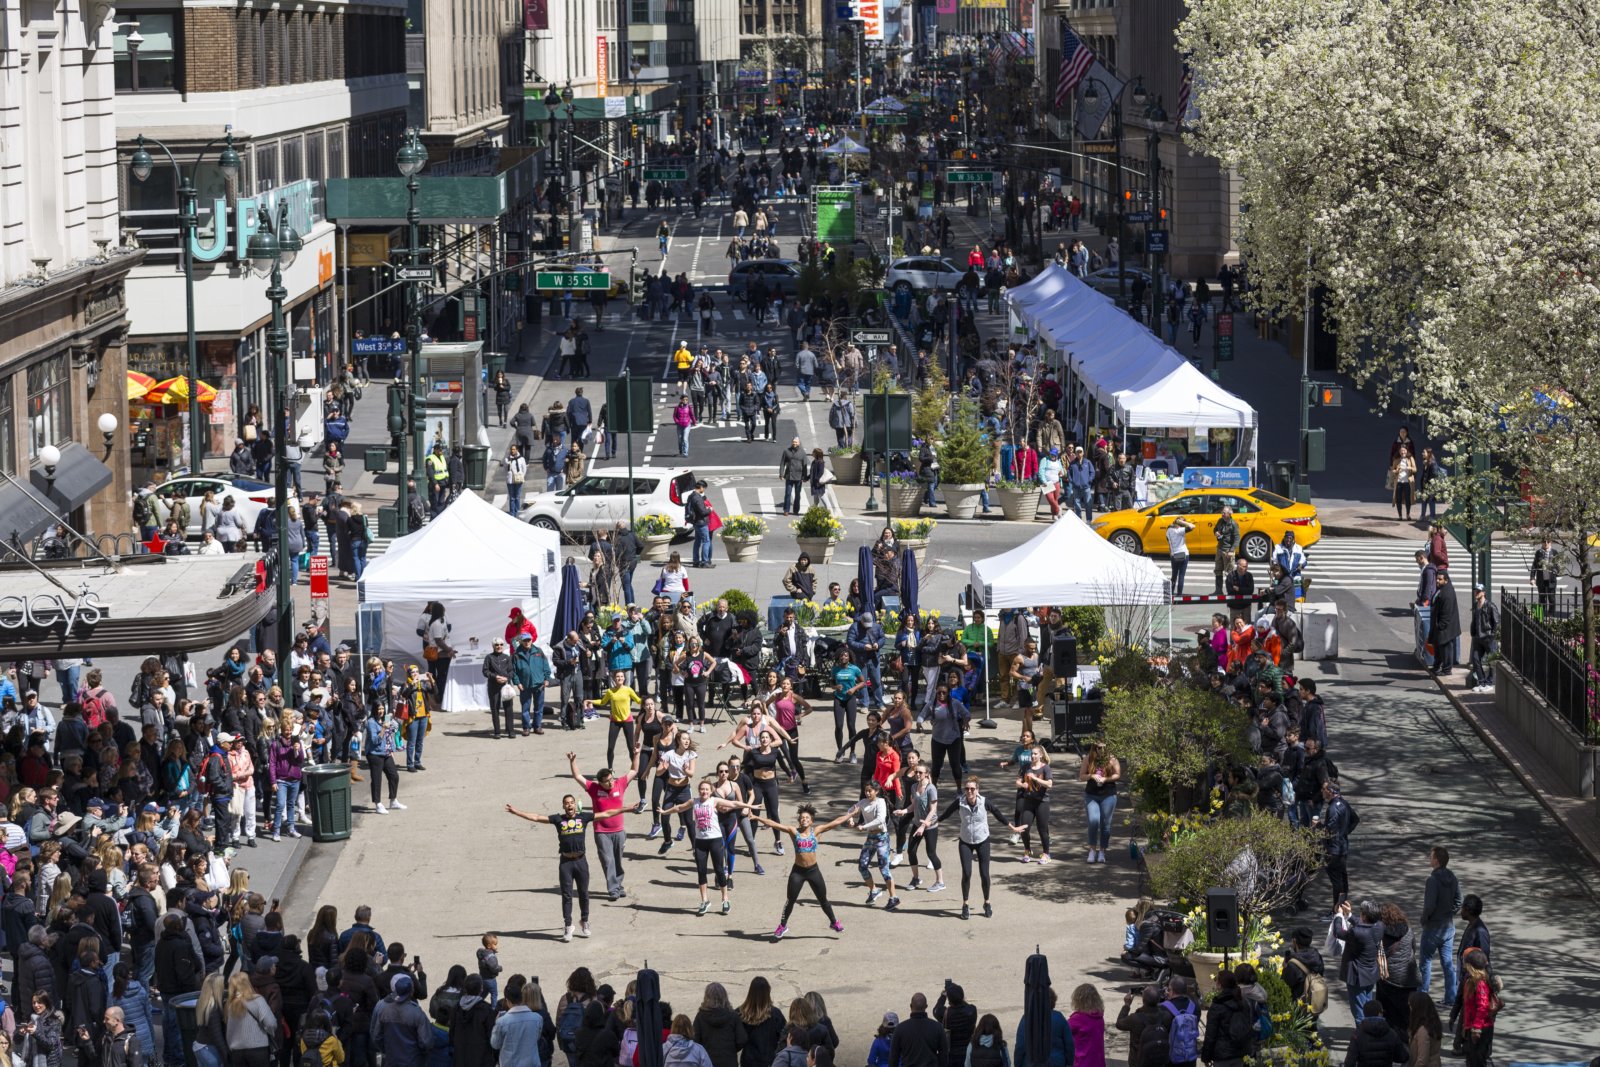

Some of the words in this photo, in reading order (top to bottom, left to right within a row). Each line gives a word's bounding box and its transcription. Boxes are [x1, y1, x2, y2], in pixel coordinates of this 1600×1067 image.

[554, 276, 563, 285] W
[568, 275, 579, 286] 35
[583, 275, 592, 285] St
[356, 343, 376, 351] West
[378, 342, 392, 351] 35th
[560, 819, 583, 830] 305
